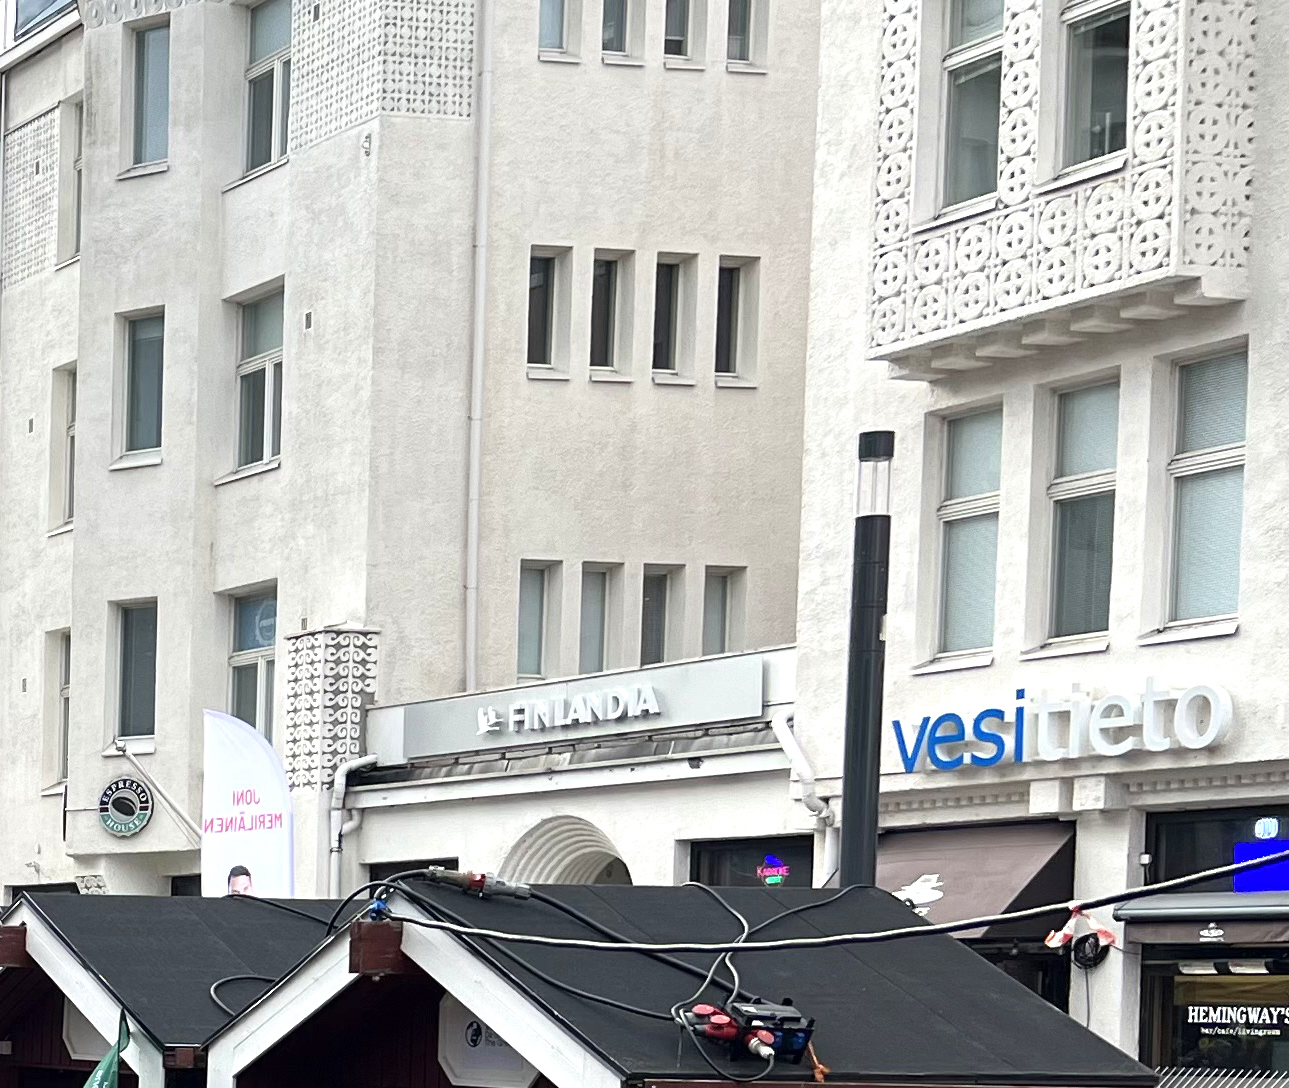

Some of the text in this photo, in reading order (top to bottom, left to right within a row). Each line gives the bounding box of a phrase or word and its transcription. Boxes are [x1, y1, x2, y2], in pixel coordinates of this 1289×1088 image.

[508, 682, 661, 732] FINLANDIA
[891, 676, 1228, 774] vesitieto
[102, 779, 148, 803] ESPRESSO
[105, 816, 143, 833] HOUSE
